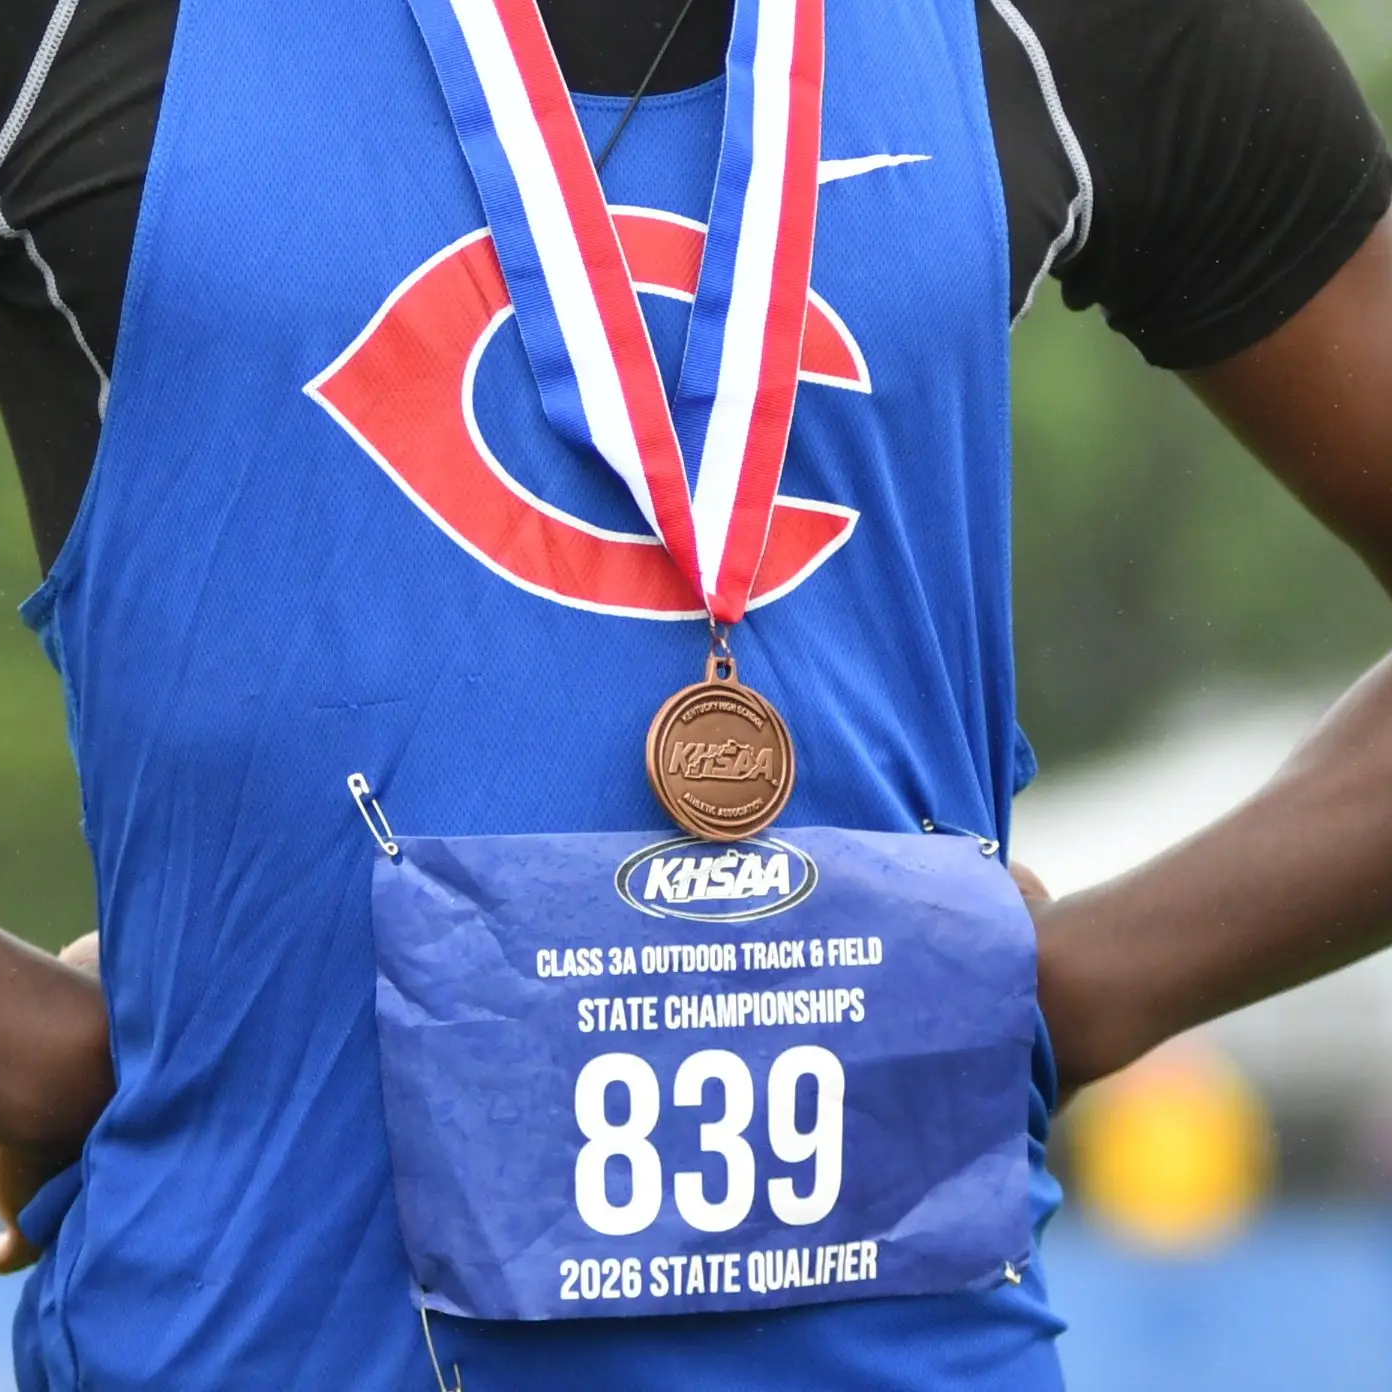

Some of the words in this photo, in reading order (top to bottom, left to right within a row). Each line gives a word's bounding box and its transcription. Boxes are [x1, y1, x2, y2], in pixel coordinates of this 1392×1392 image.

[681, 701, 718, 724] KENTUCKY
[718, 701, 737, 713] HIGH
[737, 704, 764, 730] SCHOOL
[668, 741, 773, 780] KHSAA
[683, 792, 717, 815] ATHLETIC
[644, 851, 790, 902] KHSAA
[536, 948, 603, 978] CLASS
[608, 947, 637, 976] 3A
[641, 944, 736, 975] OUTDOOR
[741, 940, 805, 970] TRACK
[810, 940, 823, 967] &
[828, 936, 883, 966] FIELD
[578, 997, 658, 1033] STATE
[664, 988, 865, 1030] CHAMPIONSHIPS
[573, 1045, 846, 1236] 839
[560, 1258, 642, 1300] 2026
[649, 1253, 741, 1298] STATE
[747, 1239, 877, 1294] QUALIFIER
